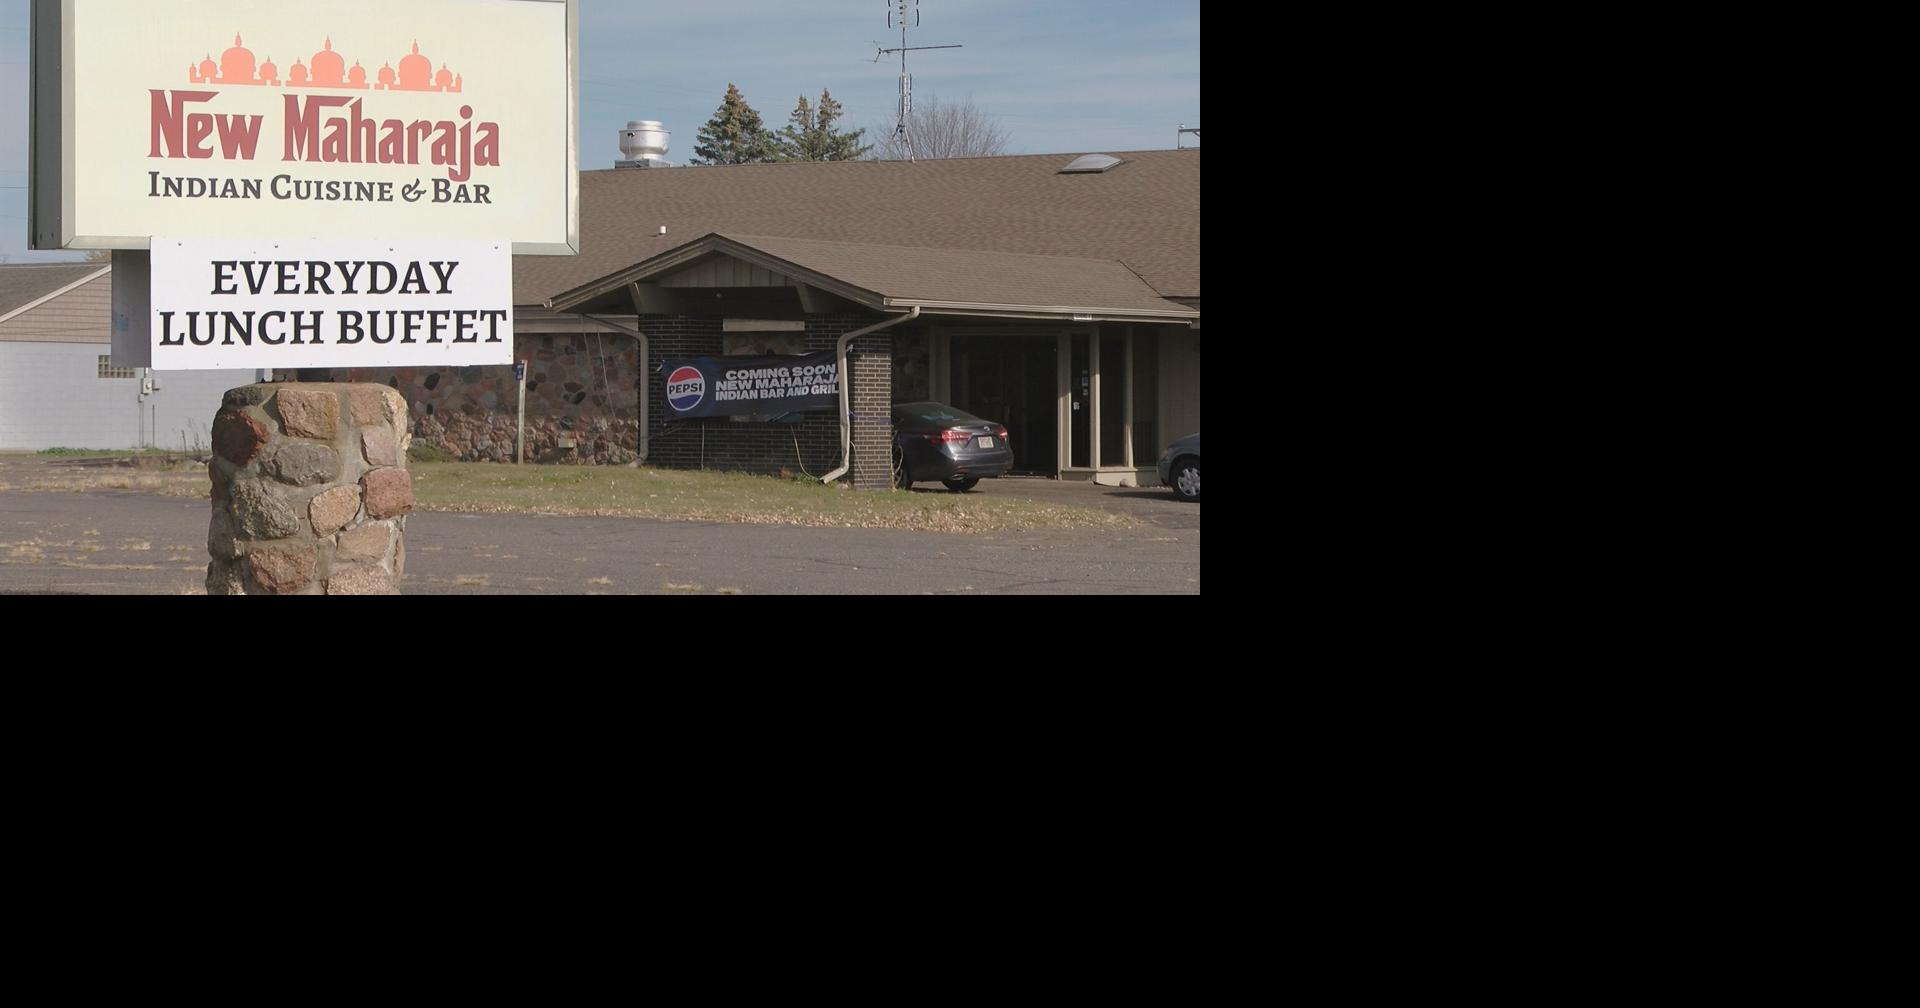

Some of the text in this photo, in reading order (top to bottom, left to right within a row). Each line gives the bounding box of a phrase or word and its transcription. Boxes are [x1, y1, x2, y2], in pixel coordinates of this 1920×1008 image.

[147, 89, 500, 182] New Maharaja
[401, 178, 427, 203] &
[210, 260, 459, 295] EVERYDAY
[159, 309, 507, 346] LUNCH BUFFET
[725, 363, 836, 380] COMING SOON
[668, 382, 703, 394] PEPSI
[715, 379, 752, 391] NEW
[715, 383, 840, 401] INDIAN BAR AND GRIL
